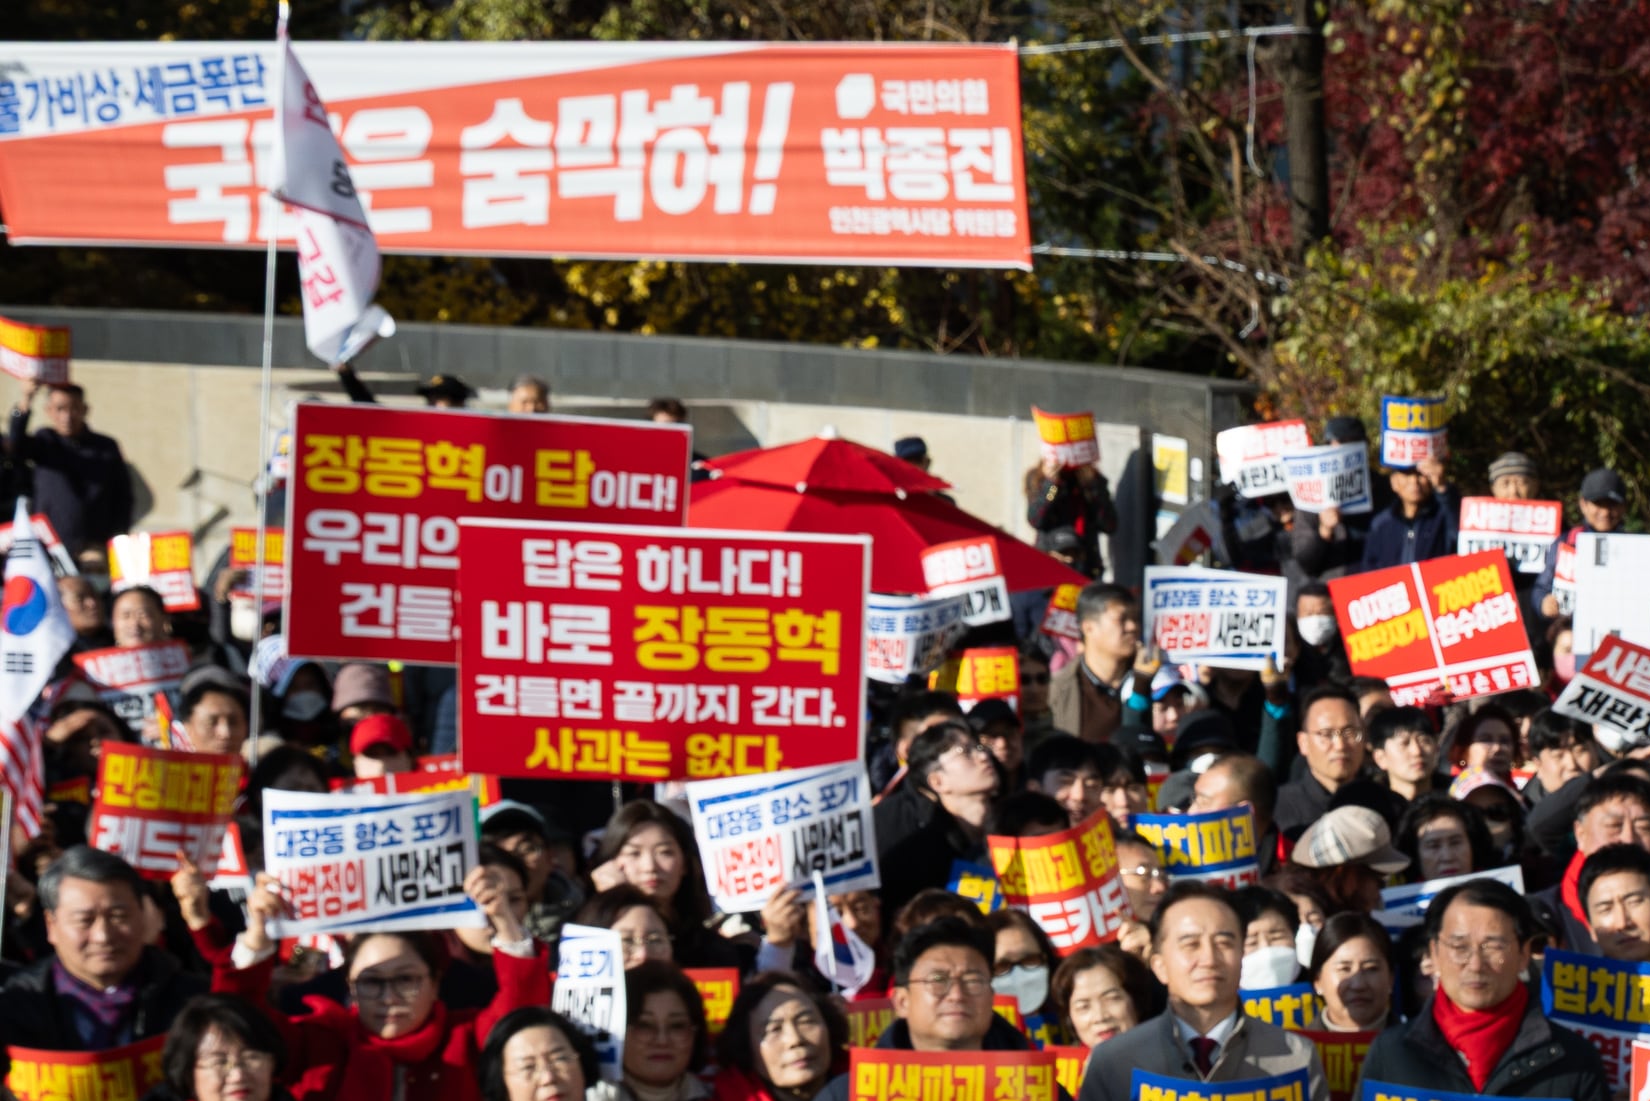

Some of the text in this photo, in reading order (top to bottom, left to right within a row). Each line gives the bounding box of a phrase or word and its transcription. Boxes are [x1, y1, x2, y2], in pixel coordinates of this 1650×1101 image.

[821, 127, 1016, 203] 박종진
[303, 434, 677, 512] 장동혁이 답이다!
[522, 538, 802, 597] 답은 하나다!
[1433, 563, 1504, 614] 7800억
[481, 601, 612, 665] 바로
[634, 604, 841, 675] 장동혁
[475, 673, 846, 728] 건들면 끝까지 간다.
[526, 726, 671, 777] 사과는
[276, 805, 462, 858] 대장동 항소 포기
[707, 776, 858, 840] 대장동 항소 포기
[374, 841, 467, 907] 사망선고
[791, 809, 867, 879] 사망선고
